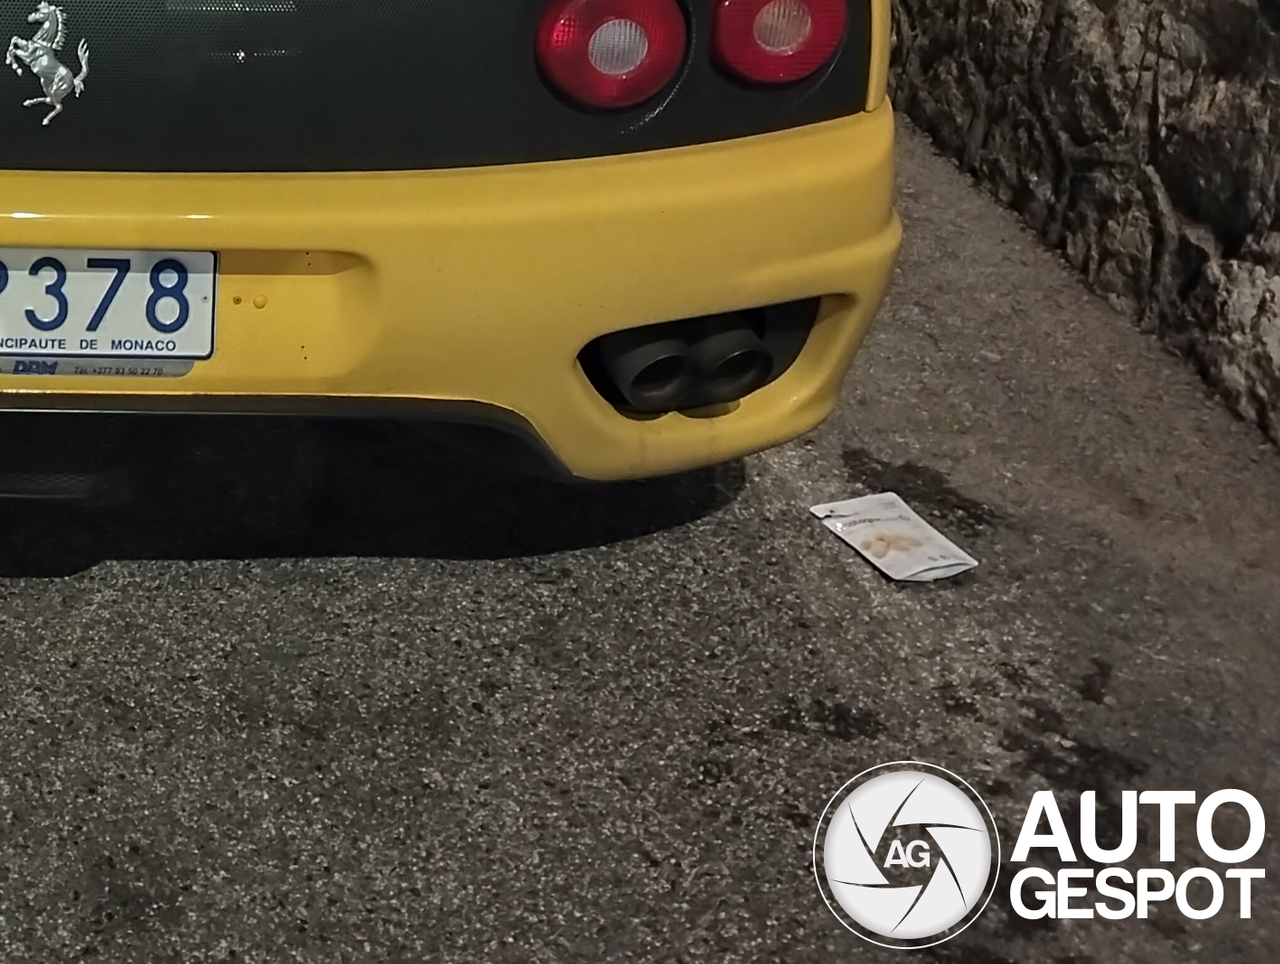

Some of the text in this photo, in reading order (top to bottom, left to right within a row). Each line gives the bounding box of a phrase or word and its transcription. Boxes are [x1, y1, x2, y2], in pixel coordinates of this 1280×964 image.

[79, 339, 98, 350] DE
[110, 339, 177, 352] MONACO
[12, 360, 58, 375] DPM
[140, 367, 150, 375] 22
